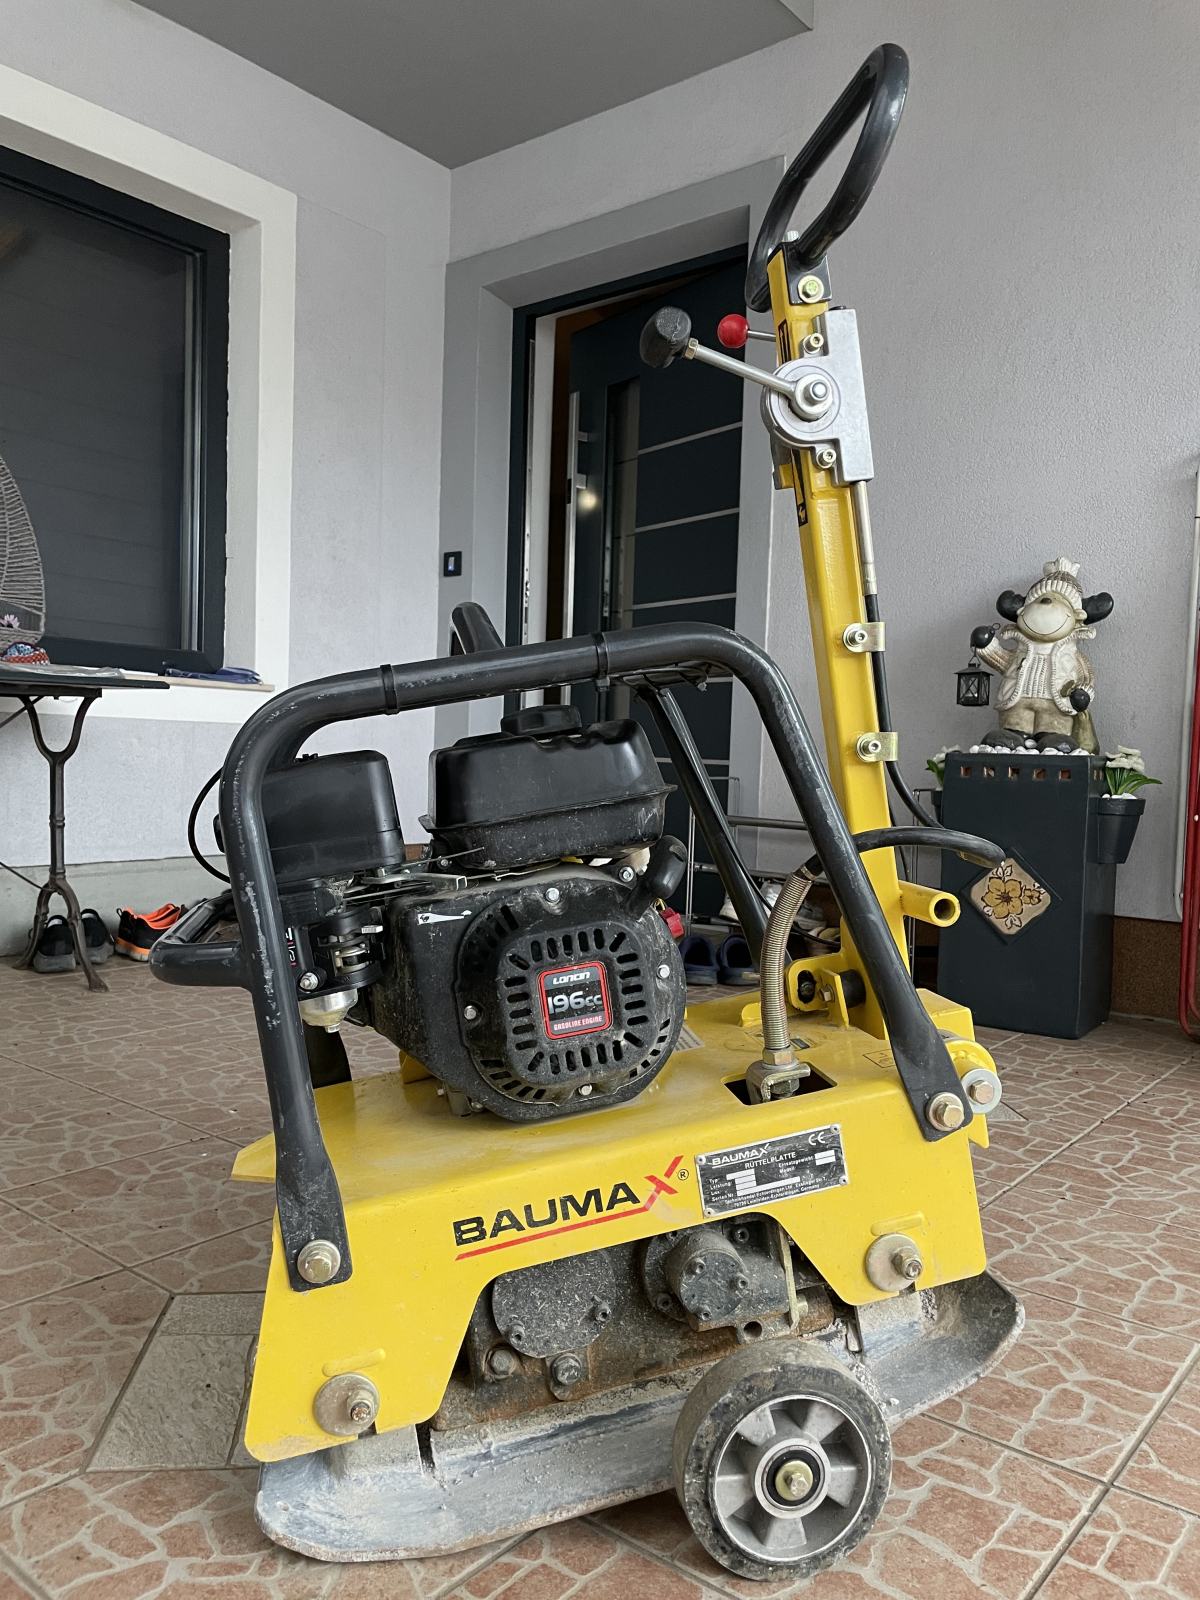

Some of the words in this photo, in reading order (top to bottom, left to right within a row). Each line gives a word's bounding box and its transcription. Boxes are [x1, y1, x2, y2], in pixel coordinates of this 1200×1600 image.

[552, 971, 591, 985] LONCIN
[546, 990, 603, 1015] 196cc
[553, 1019, 581, 1031] GASOLINE
[582, 1015, 603, 1026] ENGINE
[712, 1143, 770, 1166] BAUMAX
[744, 1152, 797, 1169] RÜTTELPLATTE
